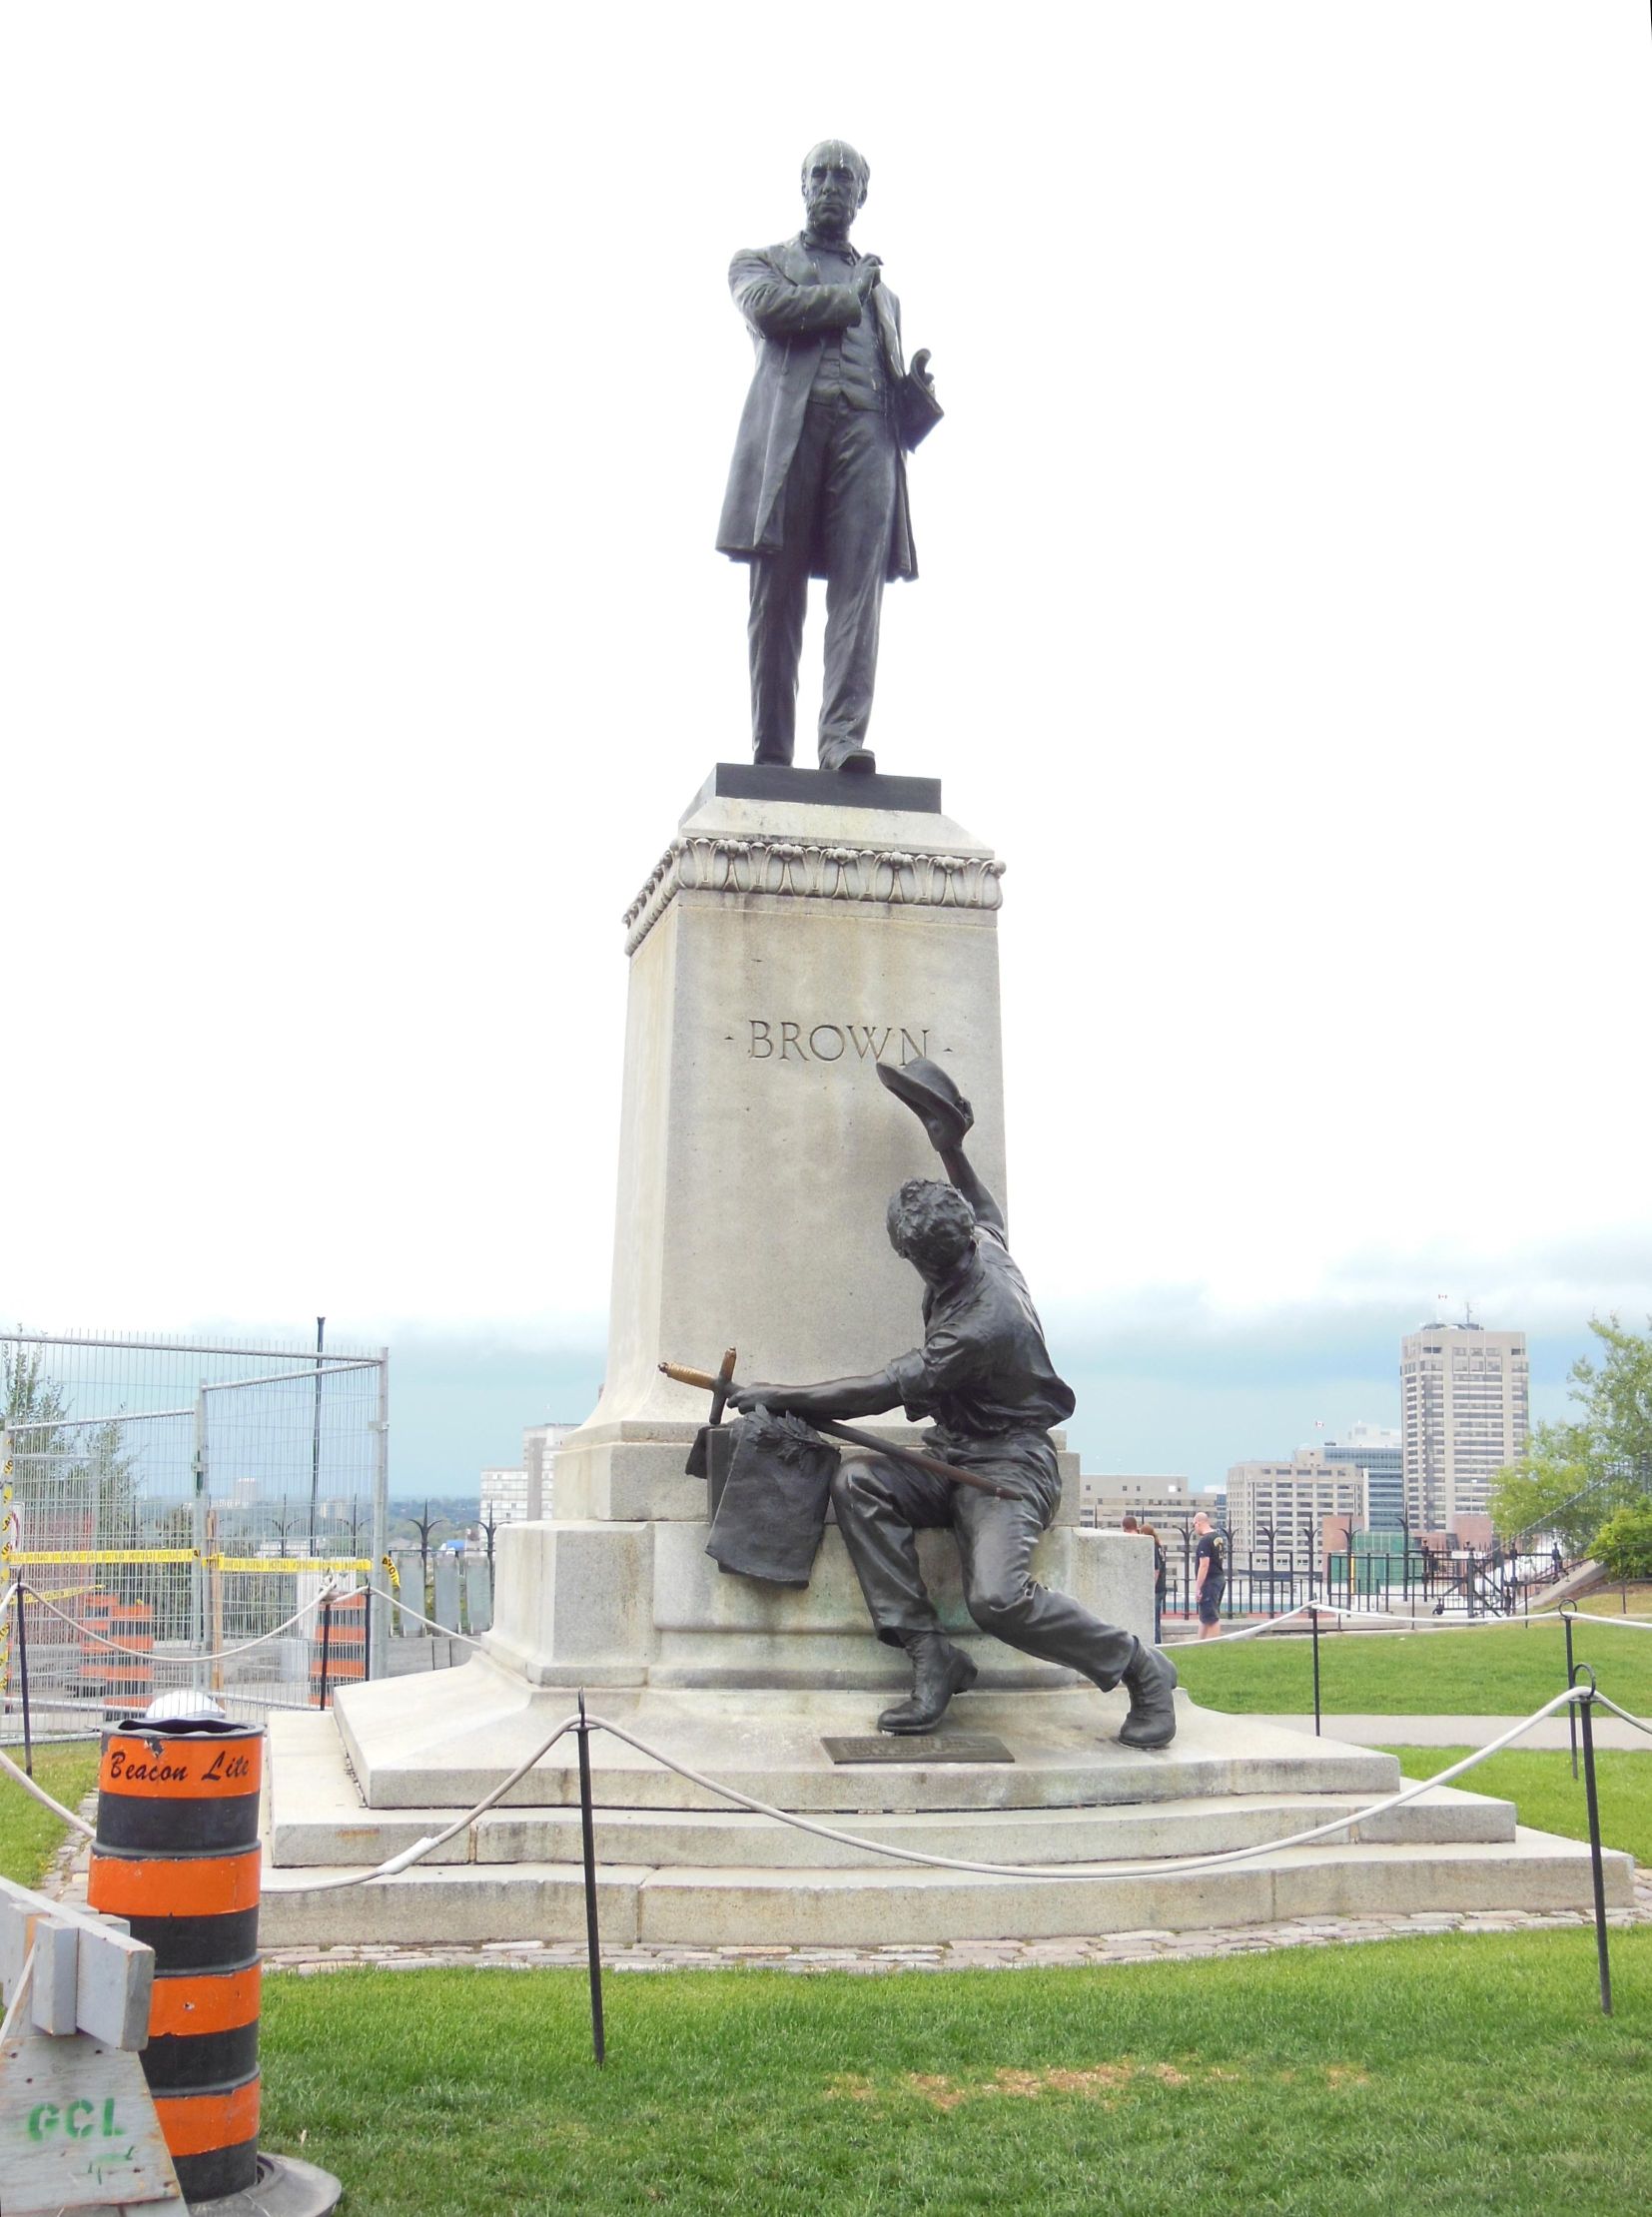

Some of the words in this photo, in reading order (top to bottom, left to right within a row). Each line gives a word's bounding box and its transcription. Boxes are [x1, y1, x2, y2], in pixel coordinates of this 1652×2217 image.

[749, 1020, 930, 1067] BROWN
[110, 1751, 189, 1782] Beacon
[201, 1750, 249, 1781] Lite
[28, 2098, 126, 2142] GCL
